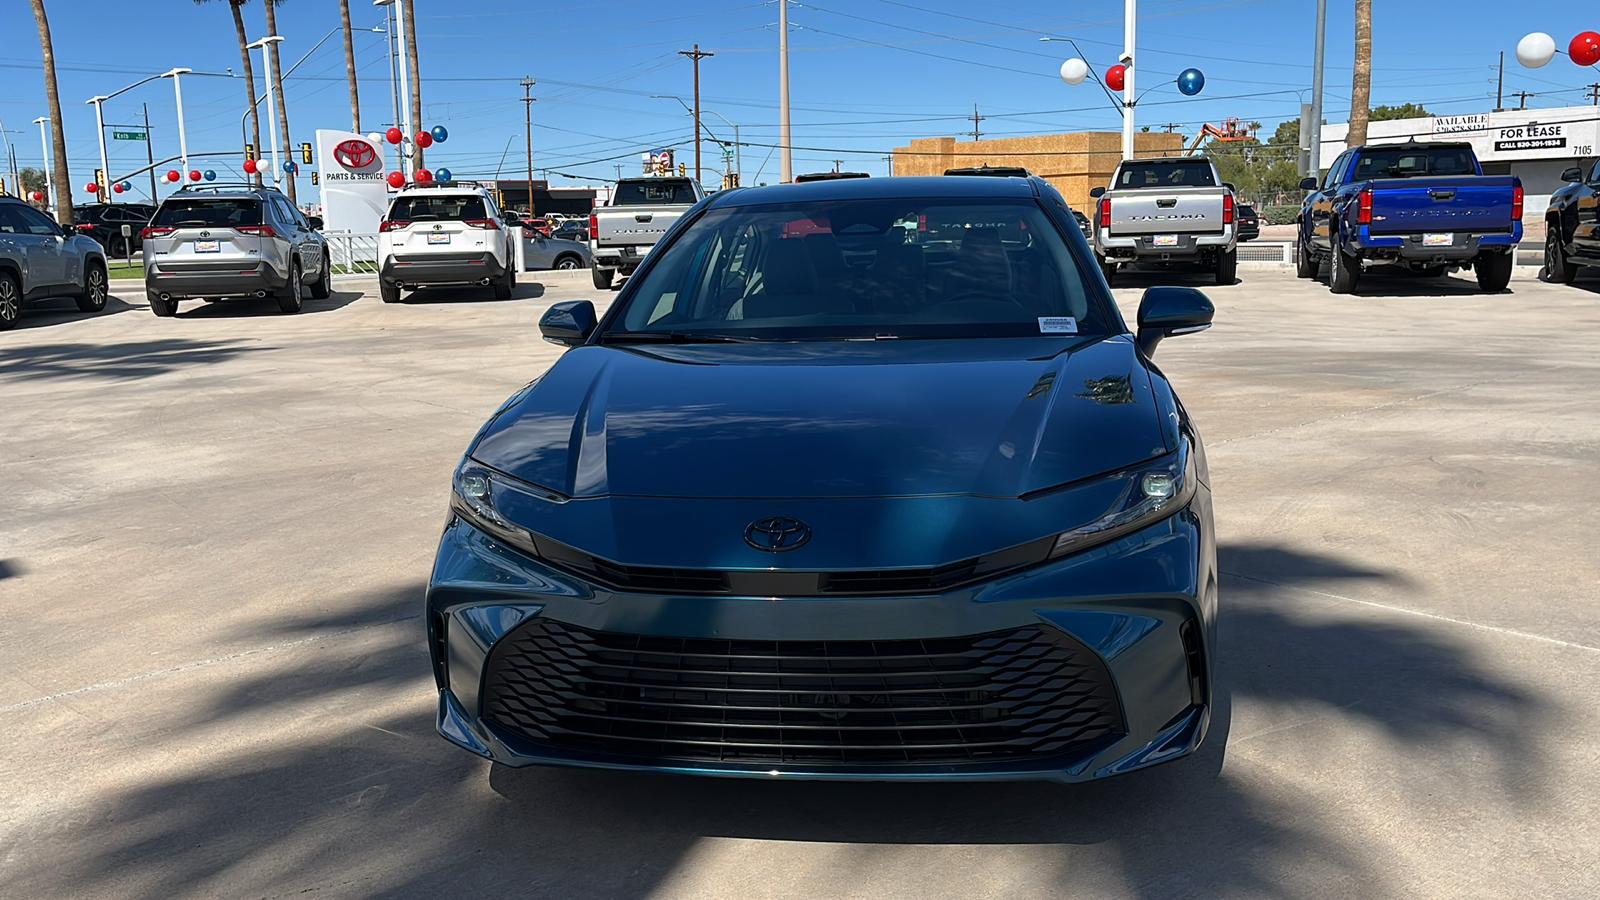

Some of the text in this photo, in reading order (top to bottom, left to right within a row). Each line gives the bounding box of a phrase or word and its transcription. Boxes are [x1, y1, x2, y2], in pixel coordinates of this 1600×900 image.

[1435, 114, 1488, 126] AVAILABLE
[1500, 126, 1562, 139] FOR LEASE
[1573, 145, 1592, 155] 7105
[326, 173, 349, 181] PARTS
[357, 172, 384, 180] SERVICE
[1129, 213, 1206, 221] TACOMA
